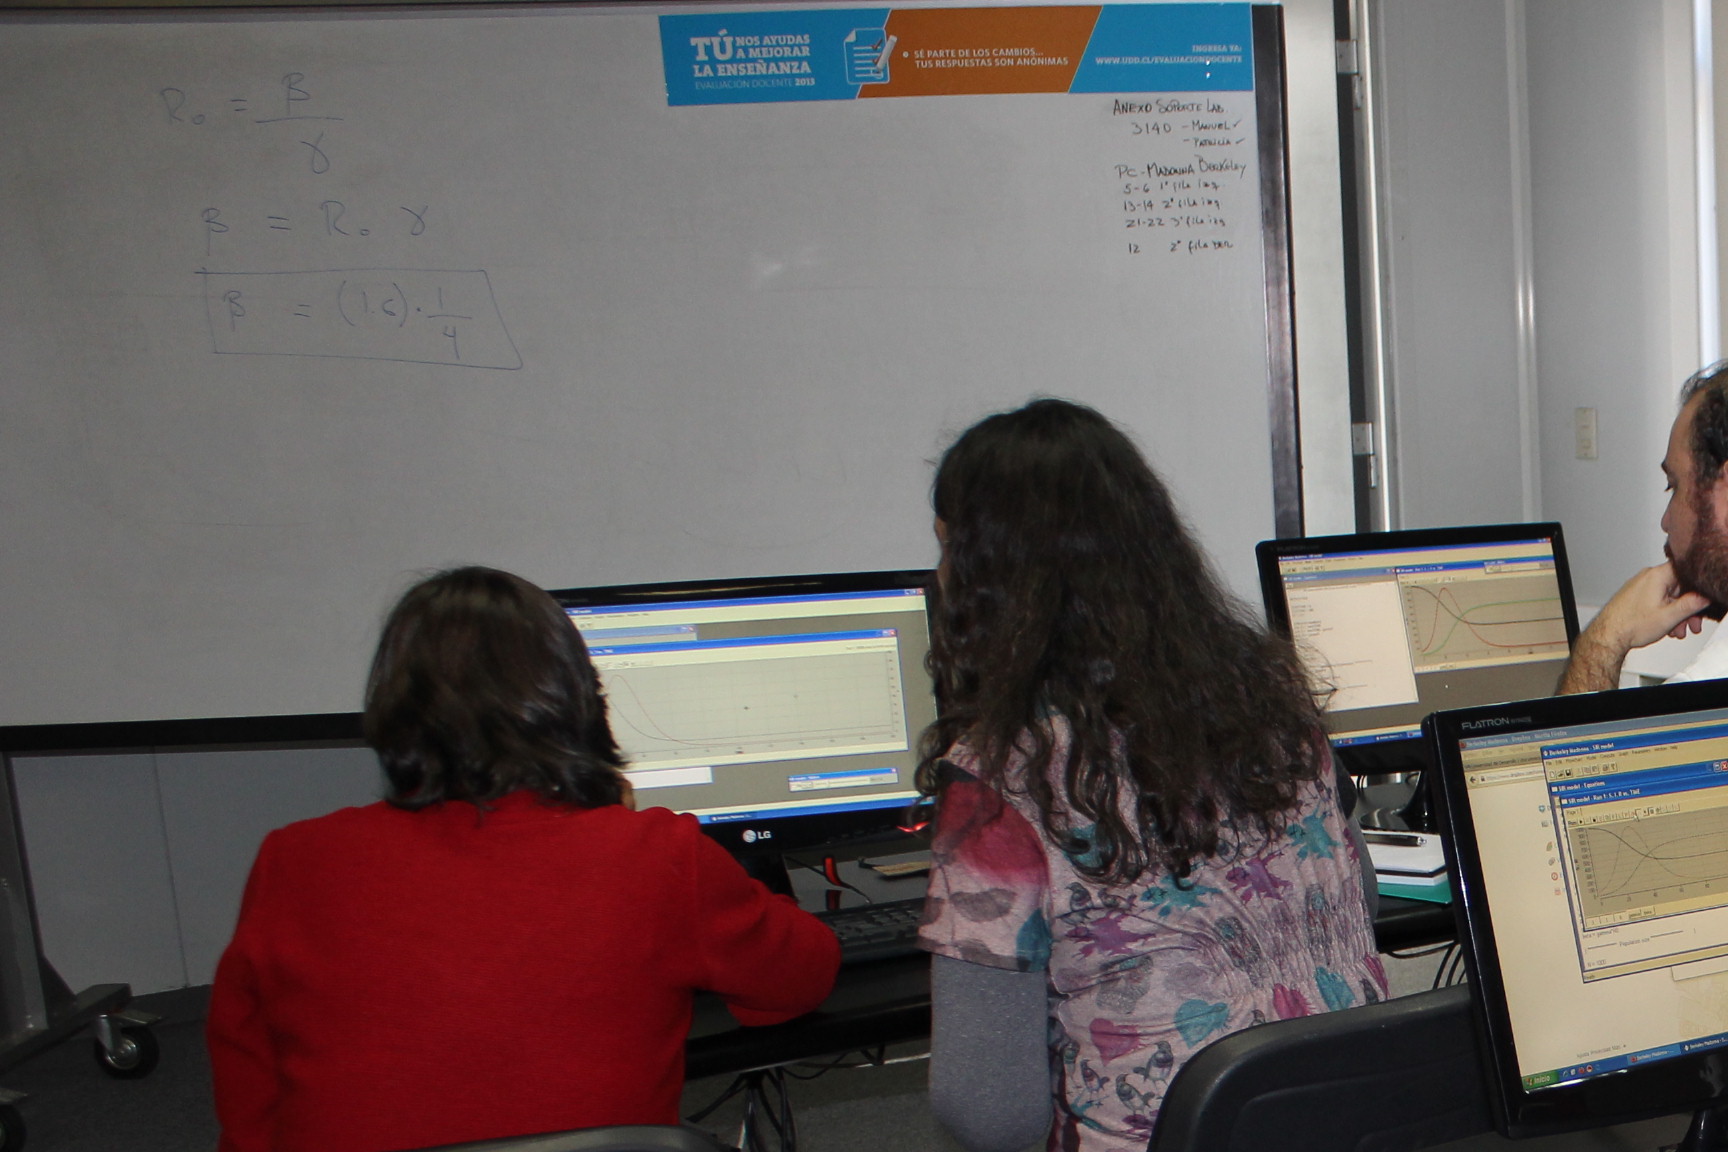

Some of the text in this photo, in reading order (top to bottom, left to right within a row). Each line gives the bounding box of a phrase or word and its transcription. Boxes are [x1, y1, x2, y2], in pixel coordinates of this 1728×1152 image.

[690, 28, 733, 61] TÚ
[736, 34, 810, 46] NOS AYUDAS
[736, 46, 810, 58] A MEJORAR
[914, 47, 1044, 59] SÉ PARTE DE LOS CAMBIOS...
[1192, 44, 1227, 53] INGRESA
[693, 59, 811, 77] LA ENSEÑANZA
[915, 56, 1069, 68] TUS RESPUESTAS SON ANÓNIMAS
[752, 78, 792, 88] DOCENTE
[795, 77, 815, 86] 2013
[1113, 98, 1153, 116] ANEXO
[1131, 121, 1172, 135] 3140
[1124, 183, 1150, 194] 5-6
[1124, 200, 1154, 212] 13-14
[1125, 217, 1165, 228] 21-22
[1128, 243, 1141, 254] 12
[1461, 717, 1509, 730] FLATRON
[1549, 748, 1569, 756] Berkeley
[1600, 742, 1614, 750] model
[1584, 781, 1605, 789] Equations
[758, 829, 772, 840] LG
[1534, 1074, 1551, 1084] Inicio
